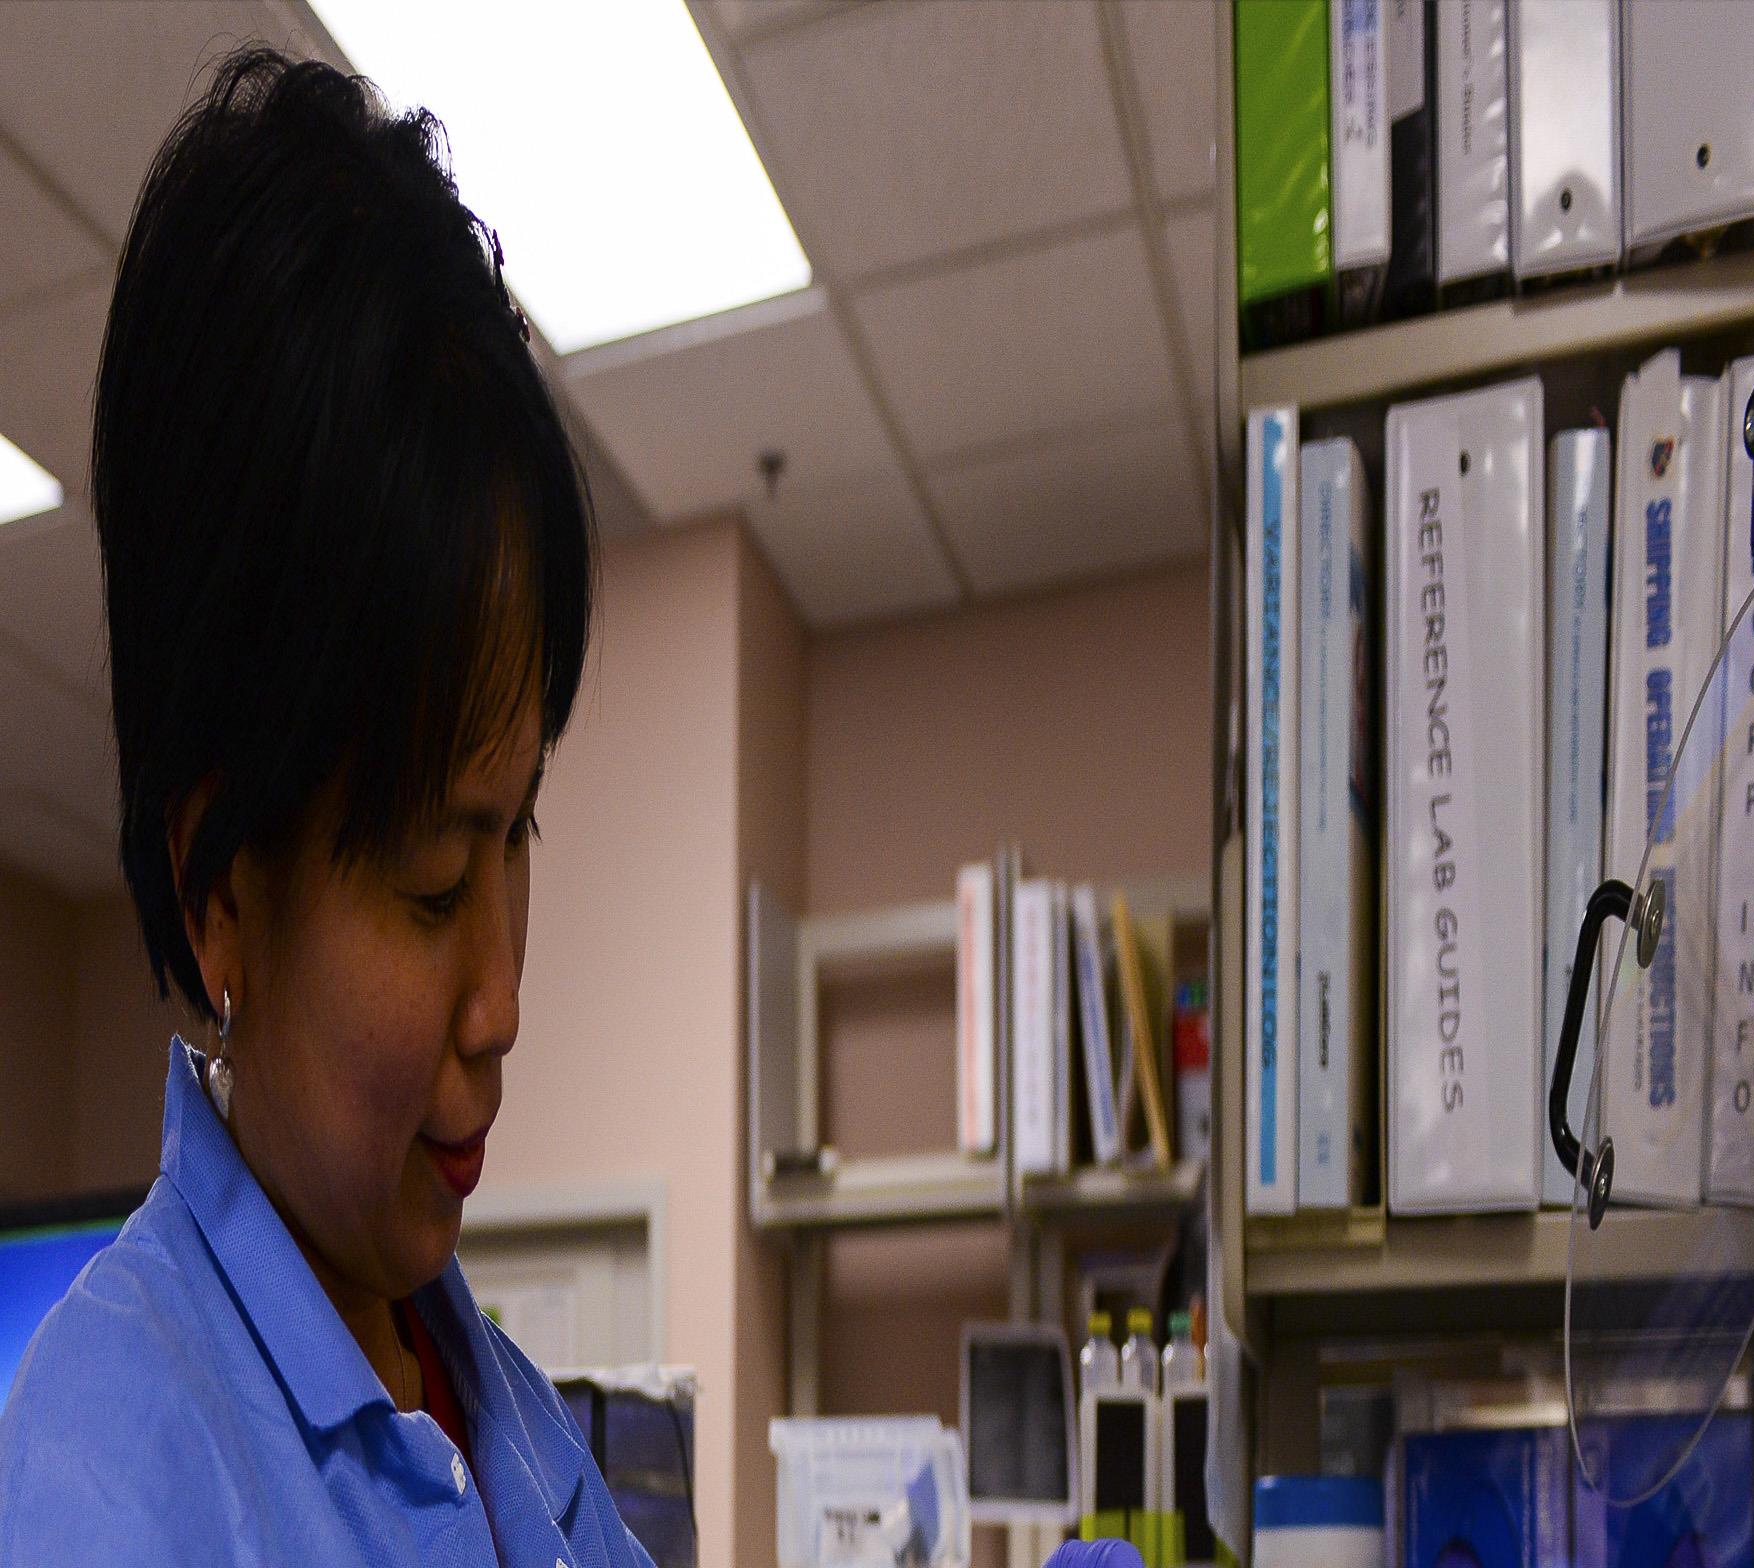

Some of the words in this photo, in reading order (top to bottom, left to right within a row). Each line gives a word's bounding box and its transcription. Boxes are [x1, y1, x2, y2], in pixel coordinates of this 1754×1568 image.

[1416, 487, 1453, 778] REFERENCE
[1645, 498, 1673, 648] SHIPPING
[1427, 793, 1457, 893] LAB
[1646, 669, 1676, 845] OPERATING
[1431, 906, 1465, 1114] GUIDES
